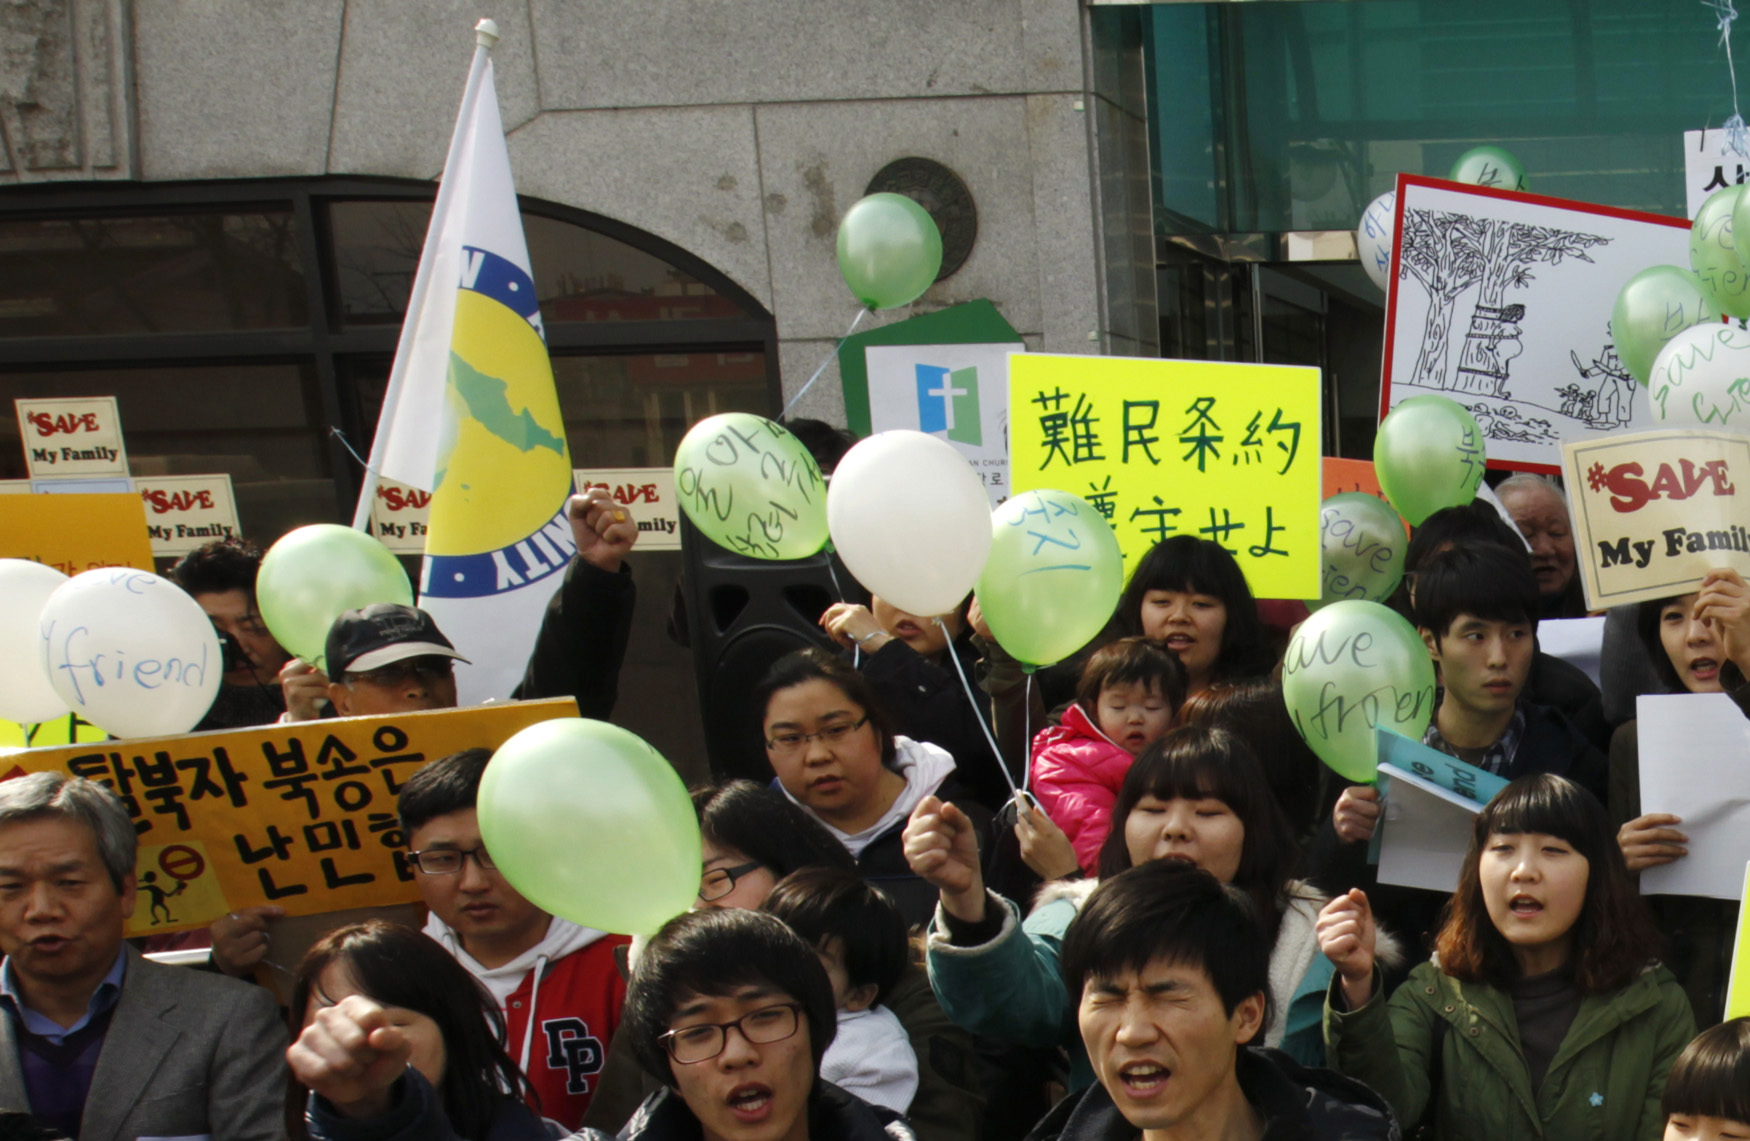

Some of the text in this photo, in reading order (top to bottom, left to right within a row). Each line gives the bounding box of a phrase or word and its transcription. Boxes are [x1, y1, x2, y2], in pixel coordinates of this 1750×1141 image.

[1031, 386, 1302, 476] 難民条約
[32, 446, 118, 464] My Family
[147, 522, 233, 541] My Family
[380, 521, 405, 539] My
[637, 516, 678, 535] mily
[1598, 536, 1656, 569] My
[261, 725, 425, 819] 북송은
